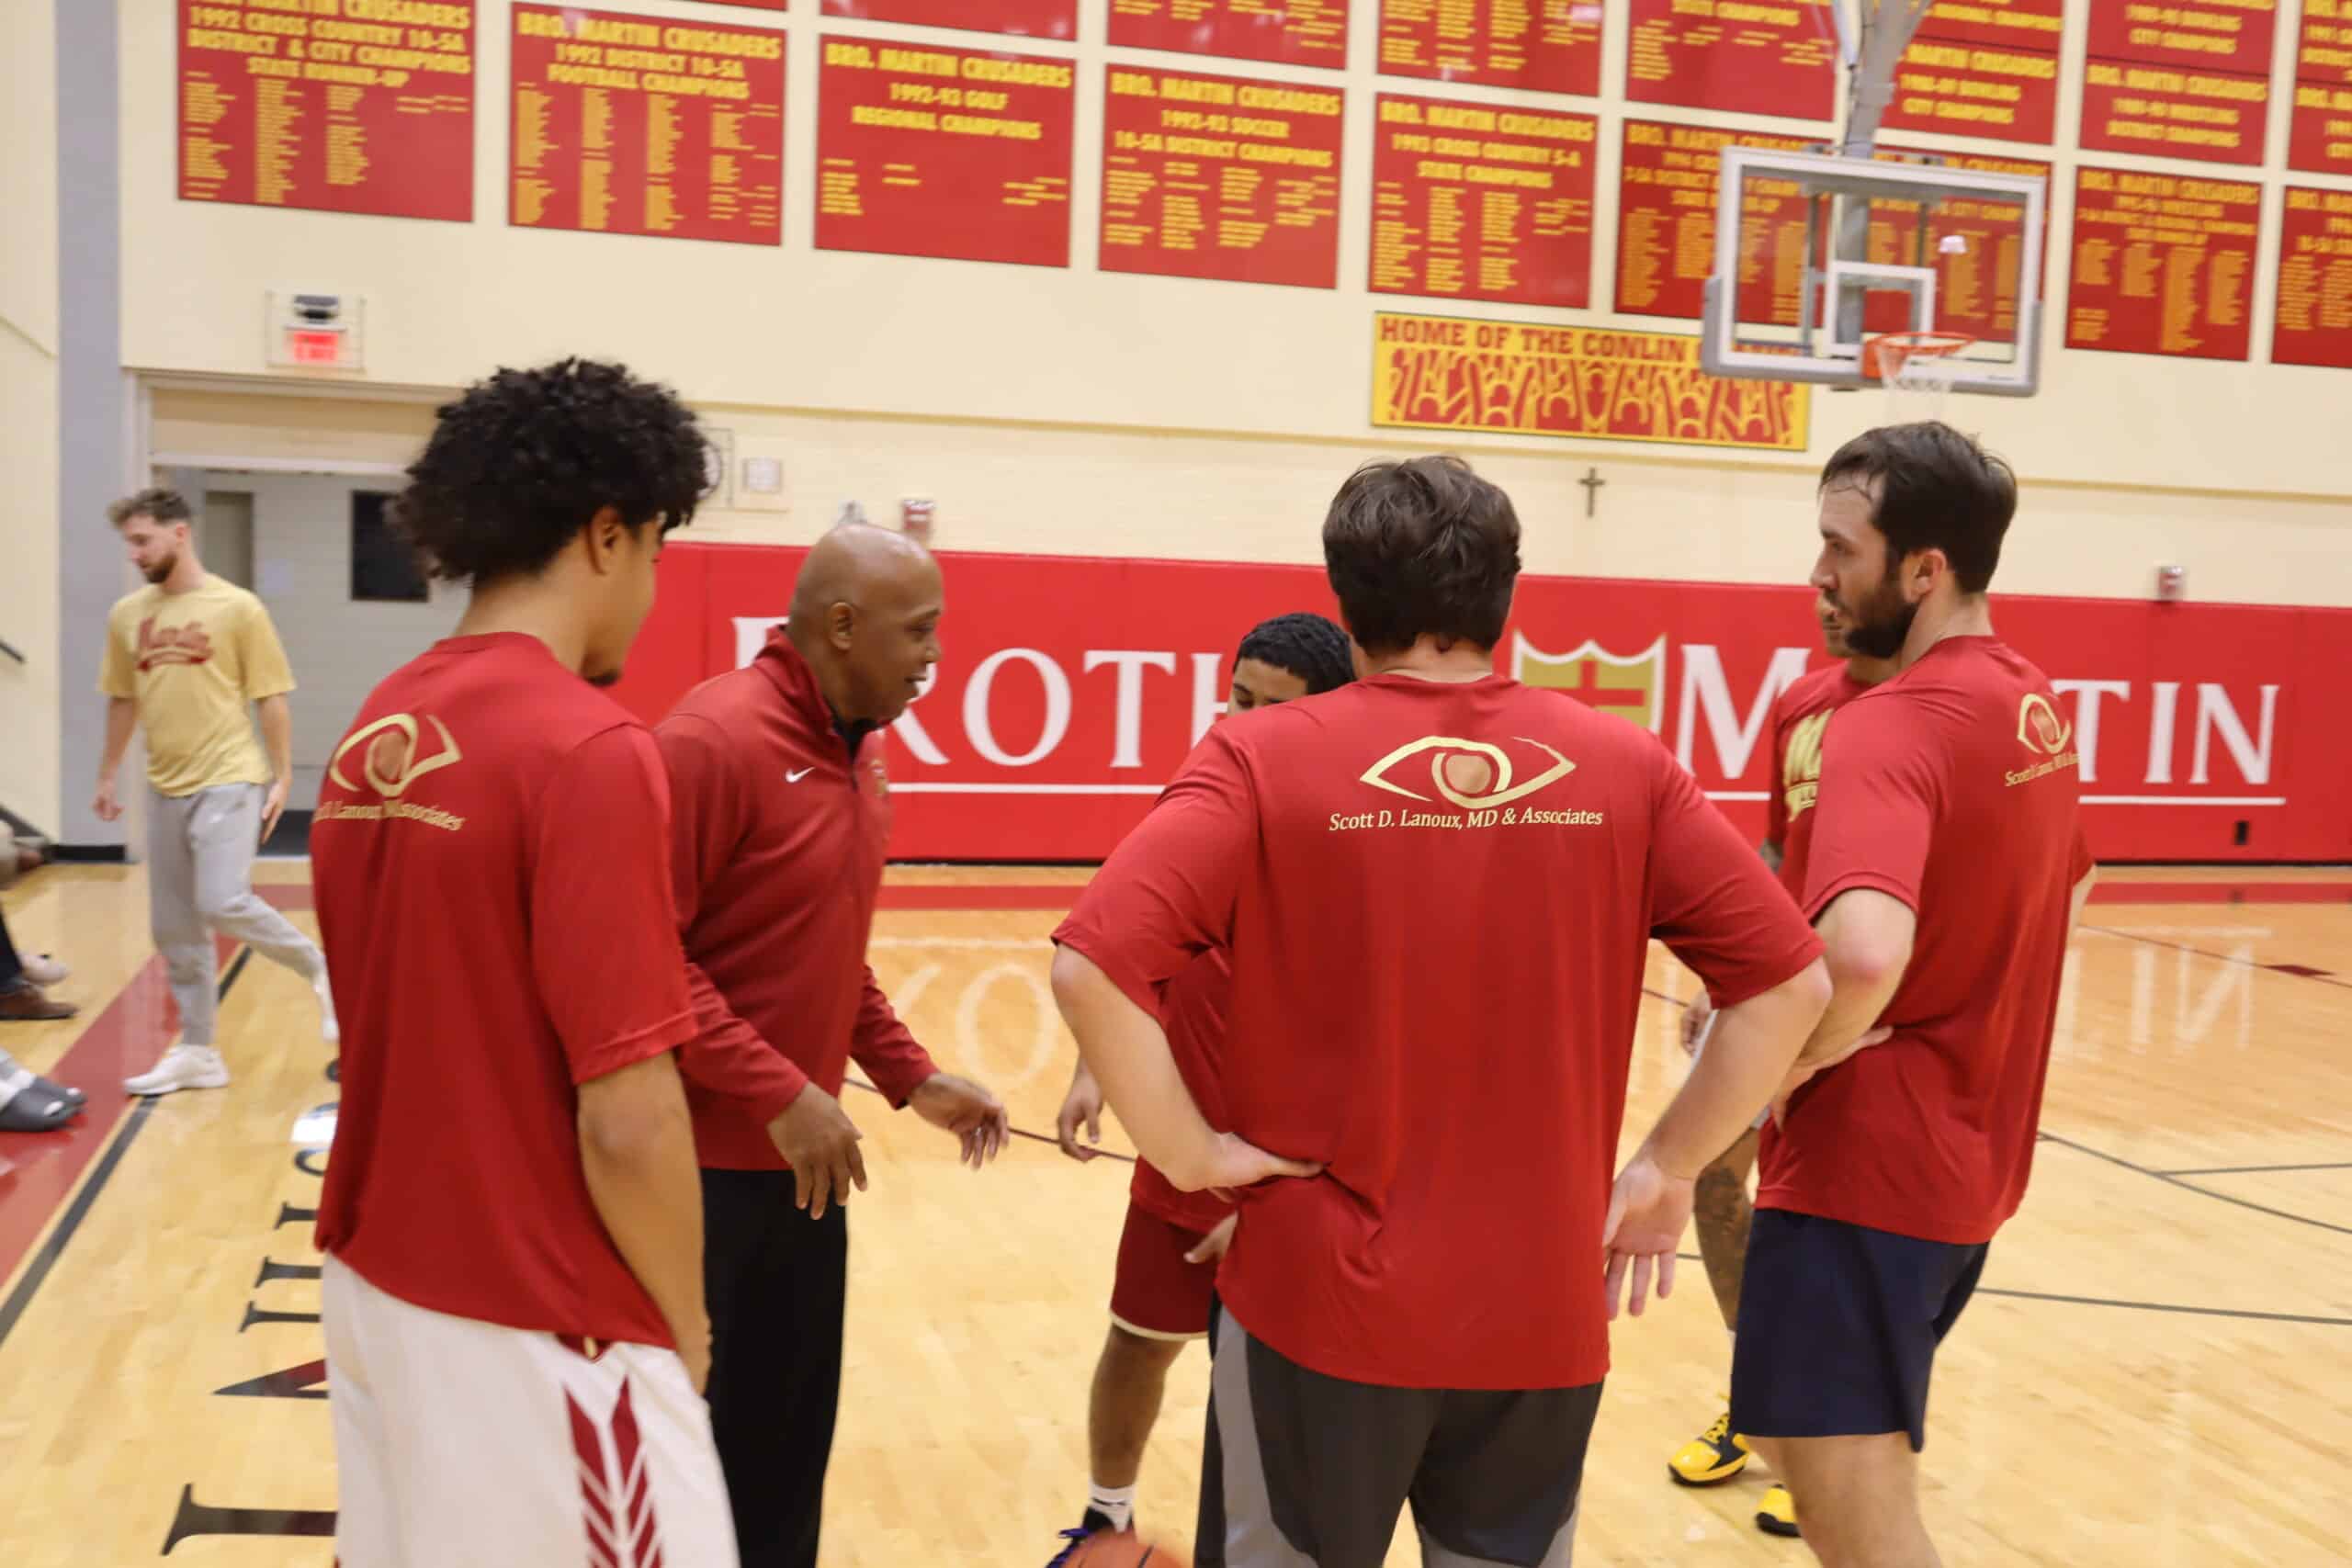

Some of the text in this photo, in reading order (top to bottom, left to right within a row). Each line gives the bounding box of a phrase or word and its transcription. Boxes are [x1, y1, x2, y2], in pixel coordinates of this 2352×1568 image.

[663, 27, 782, 60] CRUSADERS
[961, 56, 1072, 89] CRUSADERS
[1238, 85, 1341, 116] CRUSADERS
[940, 114, 1043, 141] CHAMPIONS
[1381, 316, 1467, 346] HOME
[1476, 324, 1510, 350] OF
[1521, 327, 1573, 355] THE
[1582, 332, 1687, 362] CONLIN
[1329, 807, 1604, 831] Scott D. Lanoux, MD & Associates
